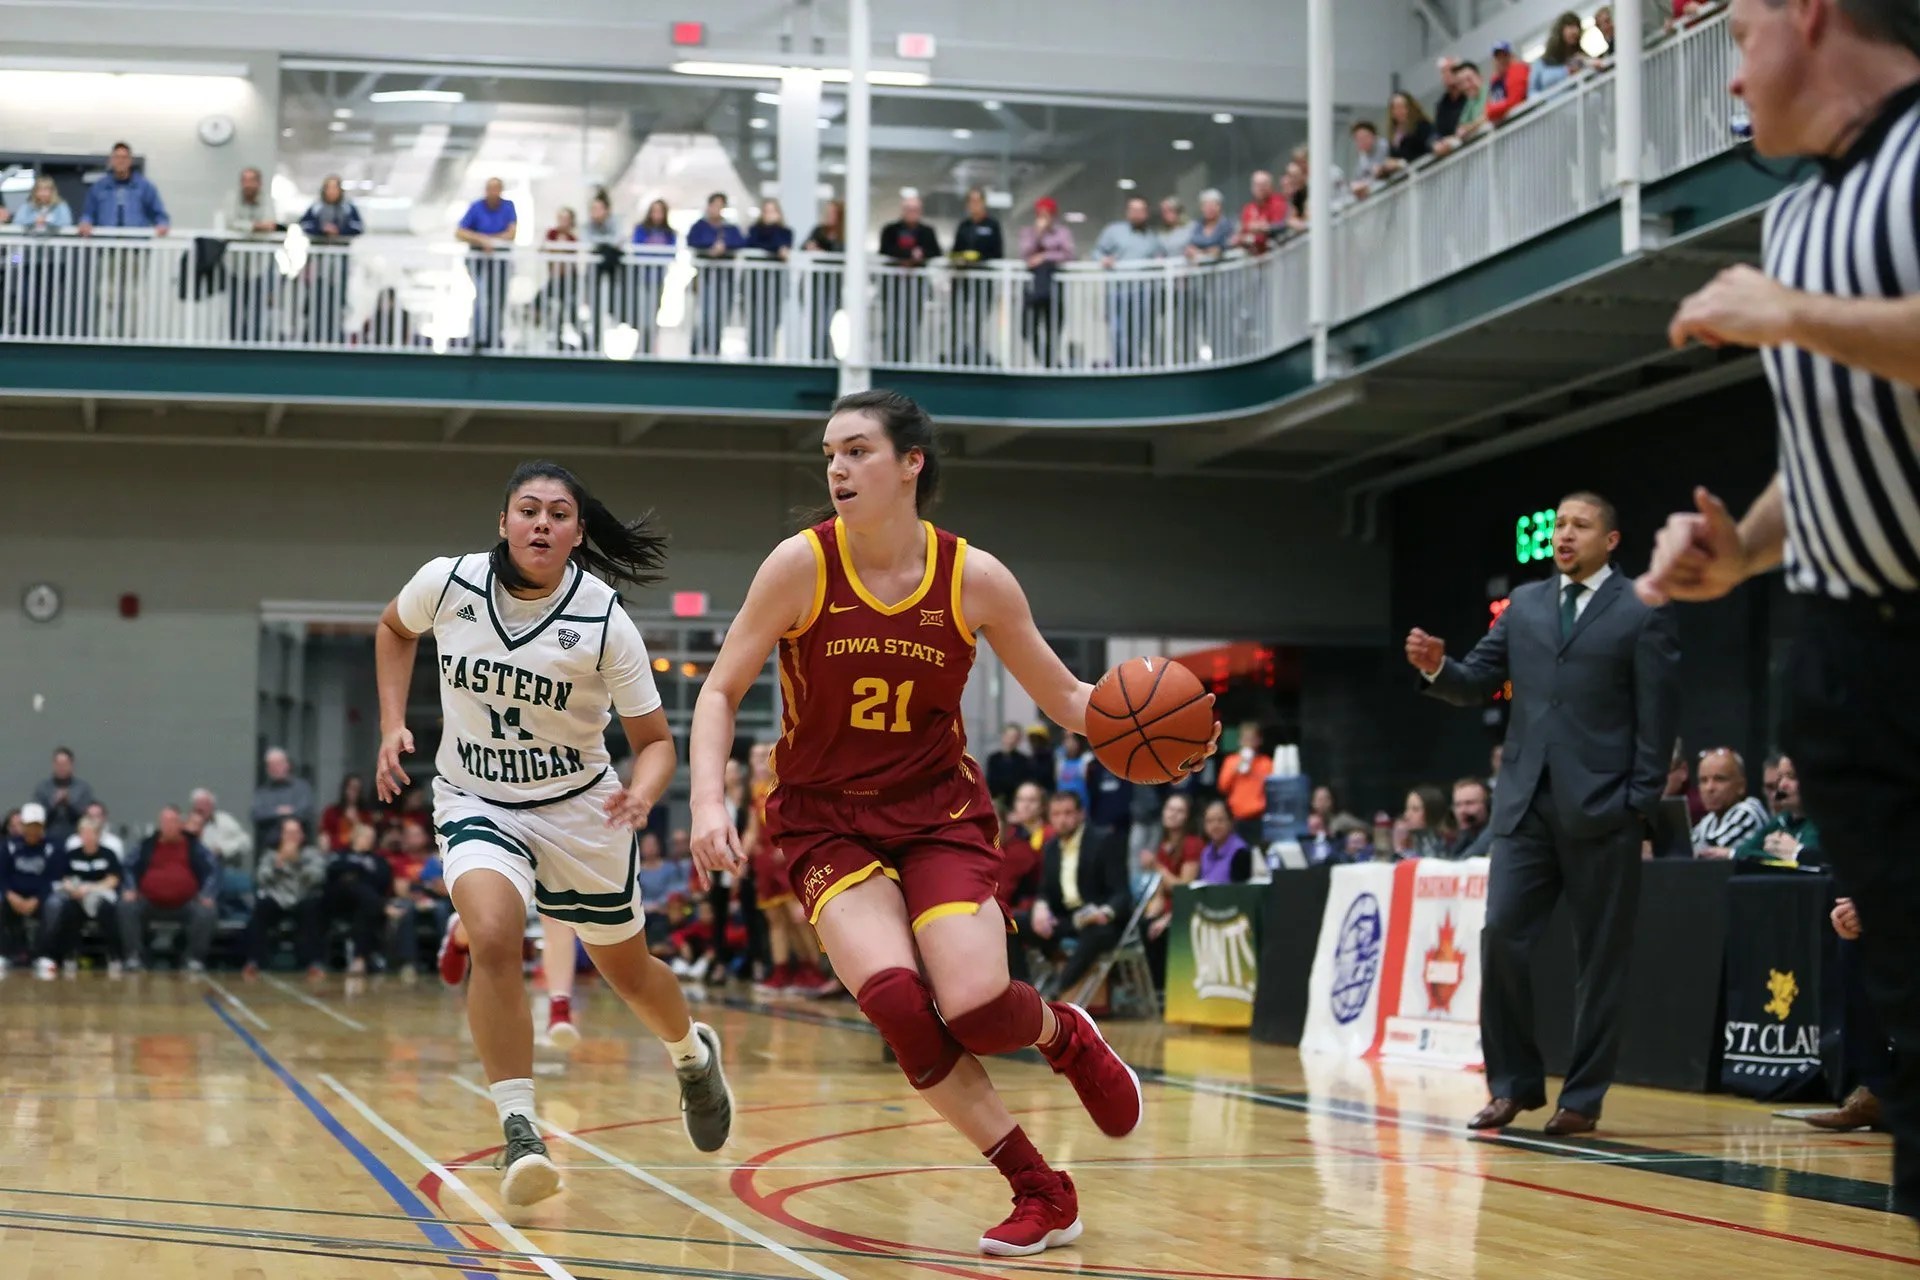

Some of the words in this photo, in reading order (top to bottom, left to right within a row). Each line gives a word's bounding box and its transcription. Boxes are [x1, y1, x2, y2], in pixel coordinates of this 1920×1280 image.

[456, 611, 477, 623] adidas
[825, 637, 880, 657] IOWA
[884, 638, 946, 668] STATE
[440, 654, 573, 712] EASTERN
[850, 677, 915, 733] 21
[457, 736, 585, 784] MICHIGAN
